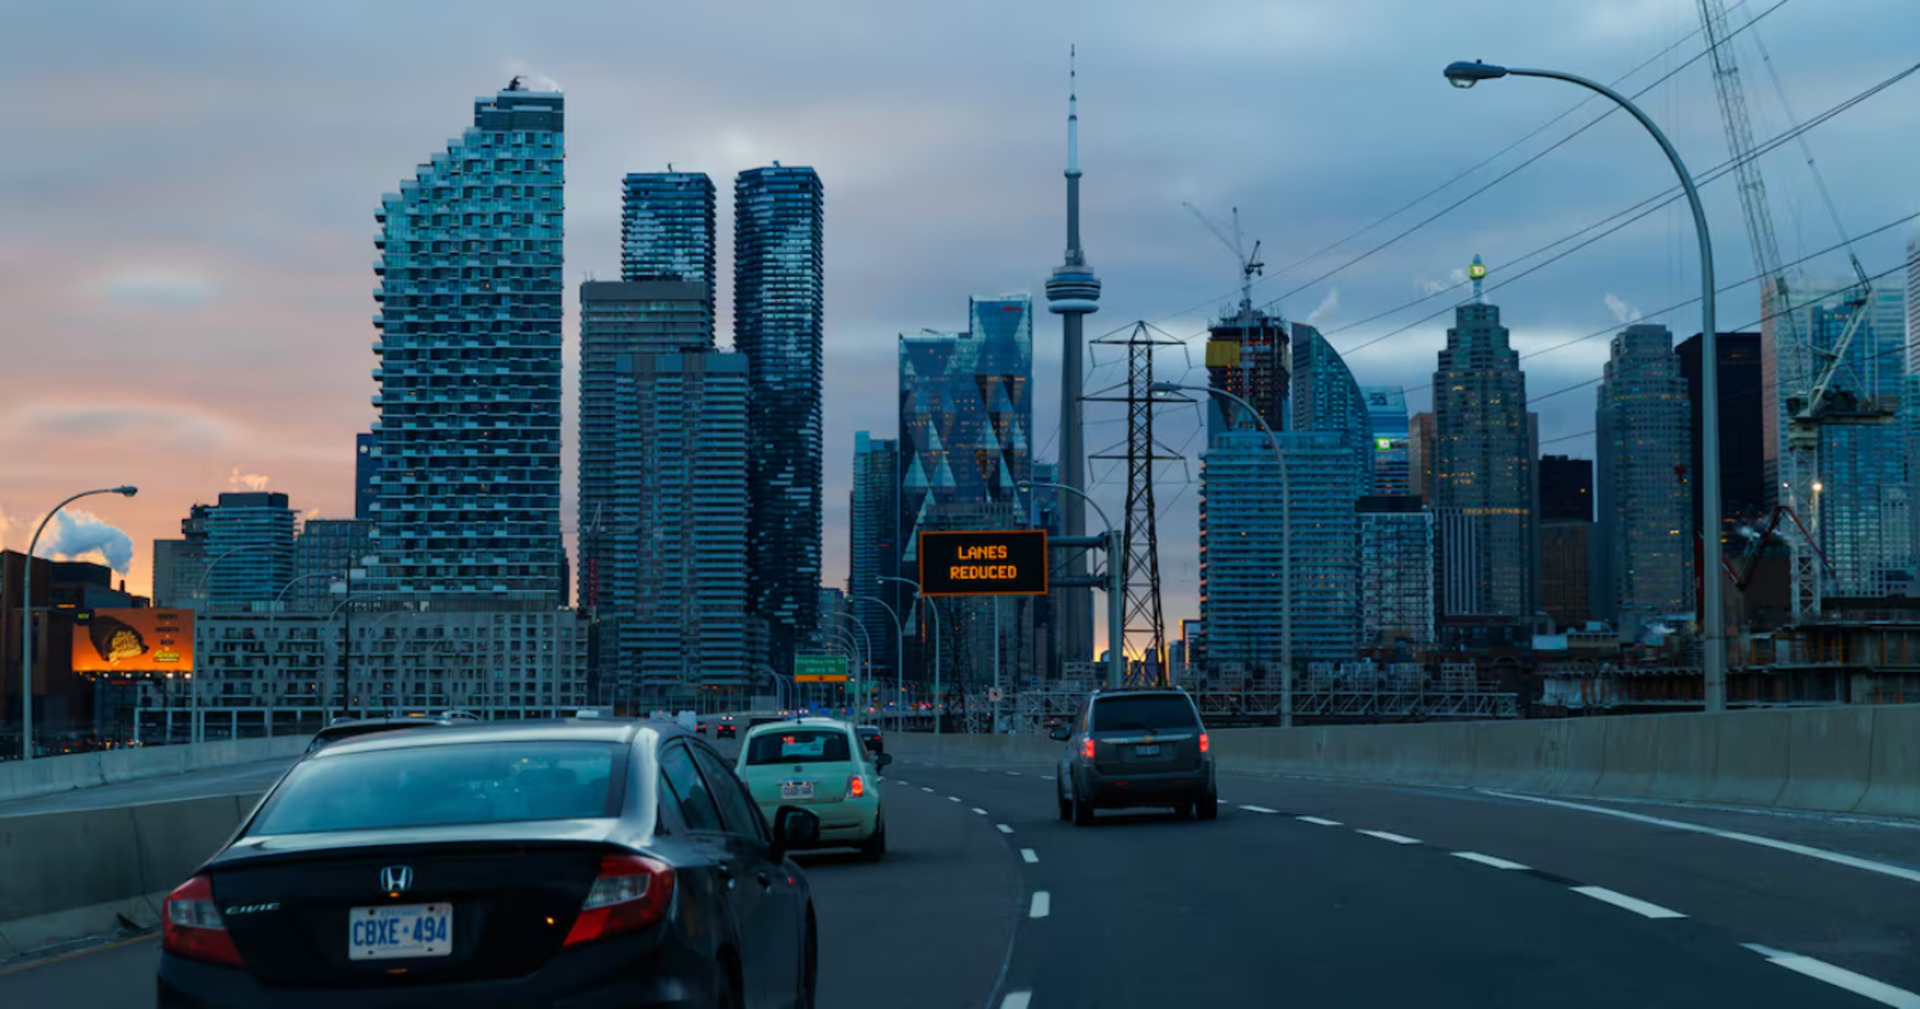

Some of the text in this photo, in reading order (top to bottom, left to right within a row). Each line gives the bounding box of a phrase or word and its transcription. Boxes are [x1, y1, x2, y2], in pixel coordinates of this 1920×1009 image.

[957, 545, 1008, 560] LANES
[949, 564, 1018, 580] REDUCED
[224, 902, 281, 915] CIVIC
[412, 915, 447, 943] 494
